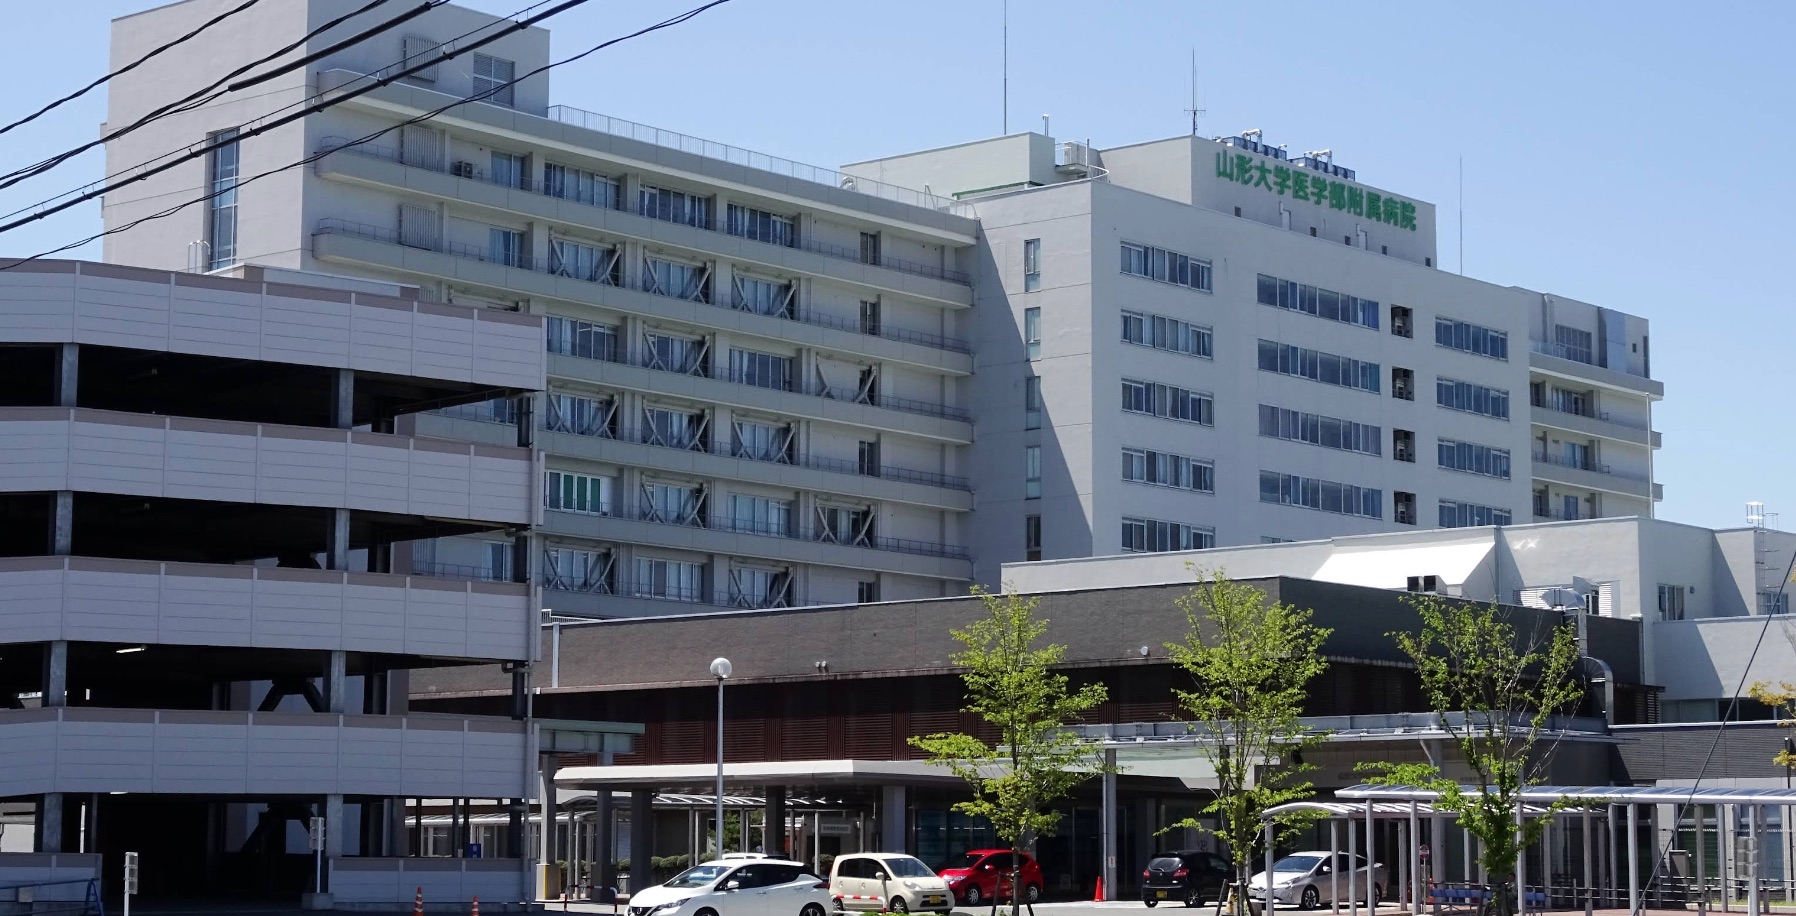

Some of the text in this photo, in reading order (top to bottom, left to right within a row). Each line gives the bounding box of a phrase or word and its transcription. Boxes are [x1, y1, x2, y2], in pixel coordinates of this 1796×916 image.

[1216, 149, 1417, 231] 山形大学医学部附属病院
